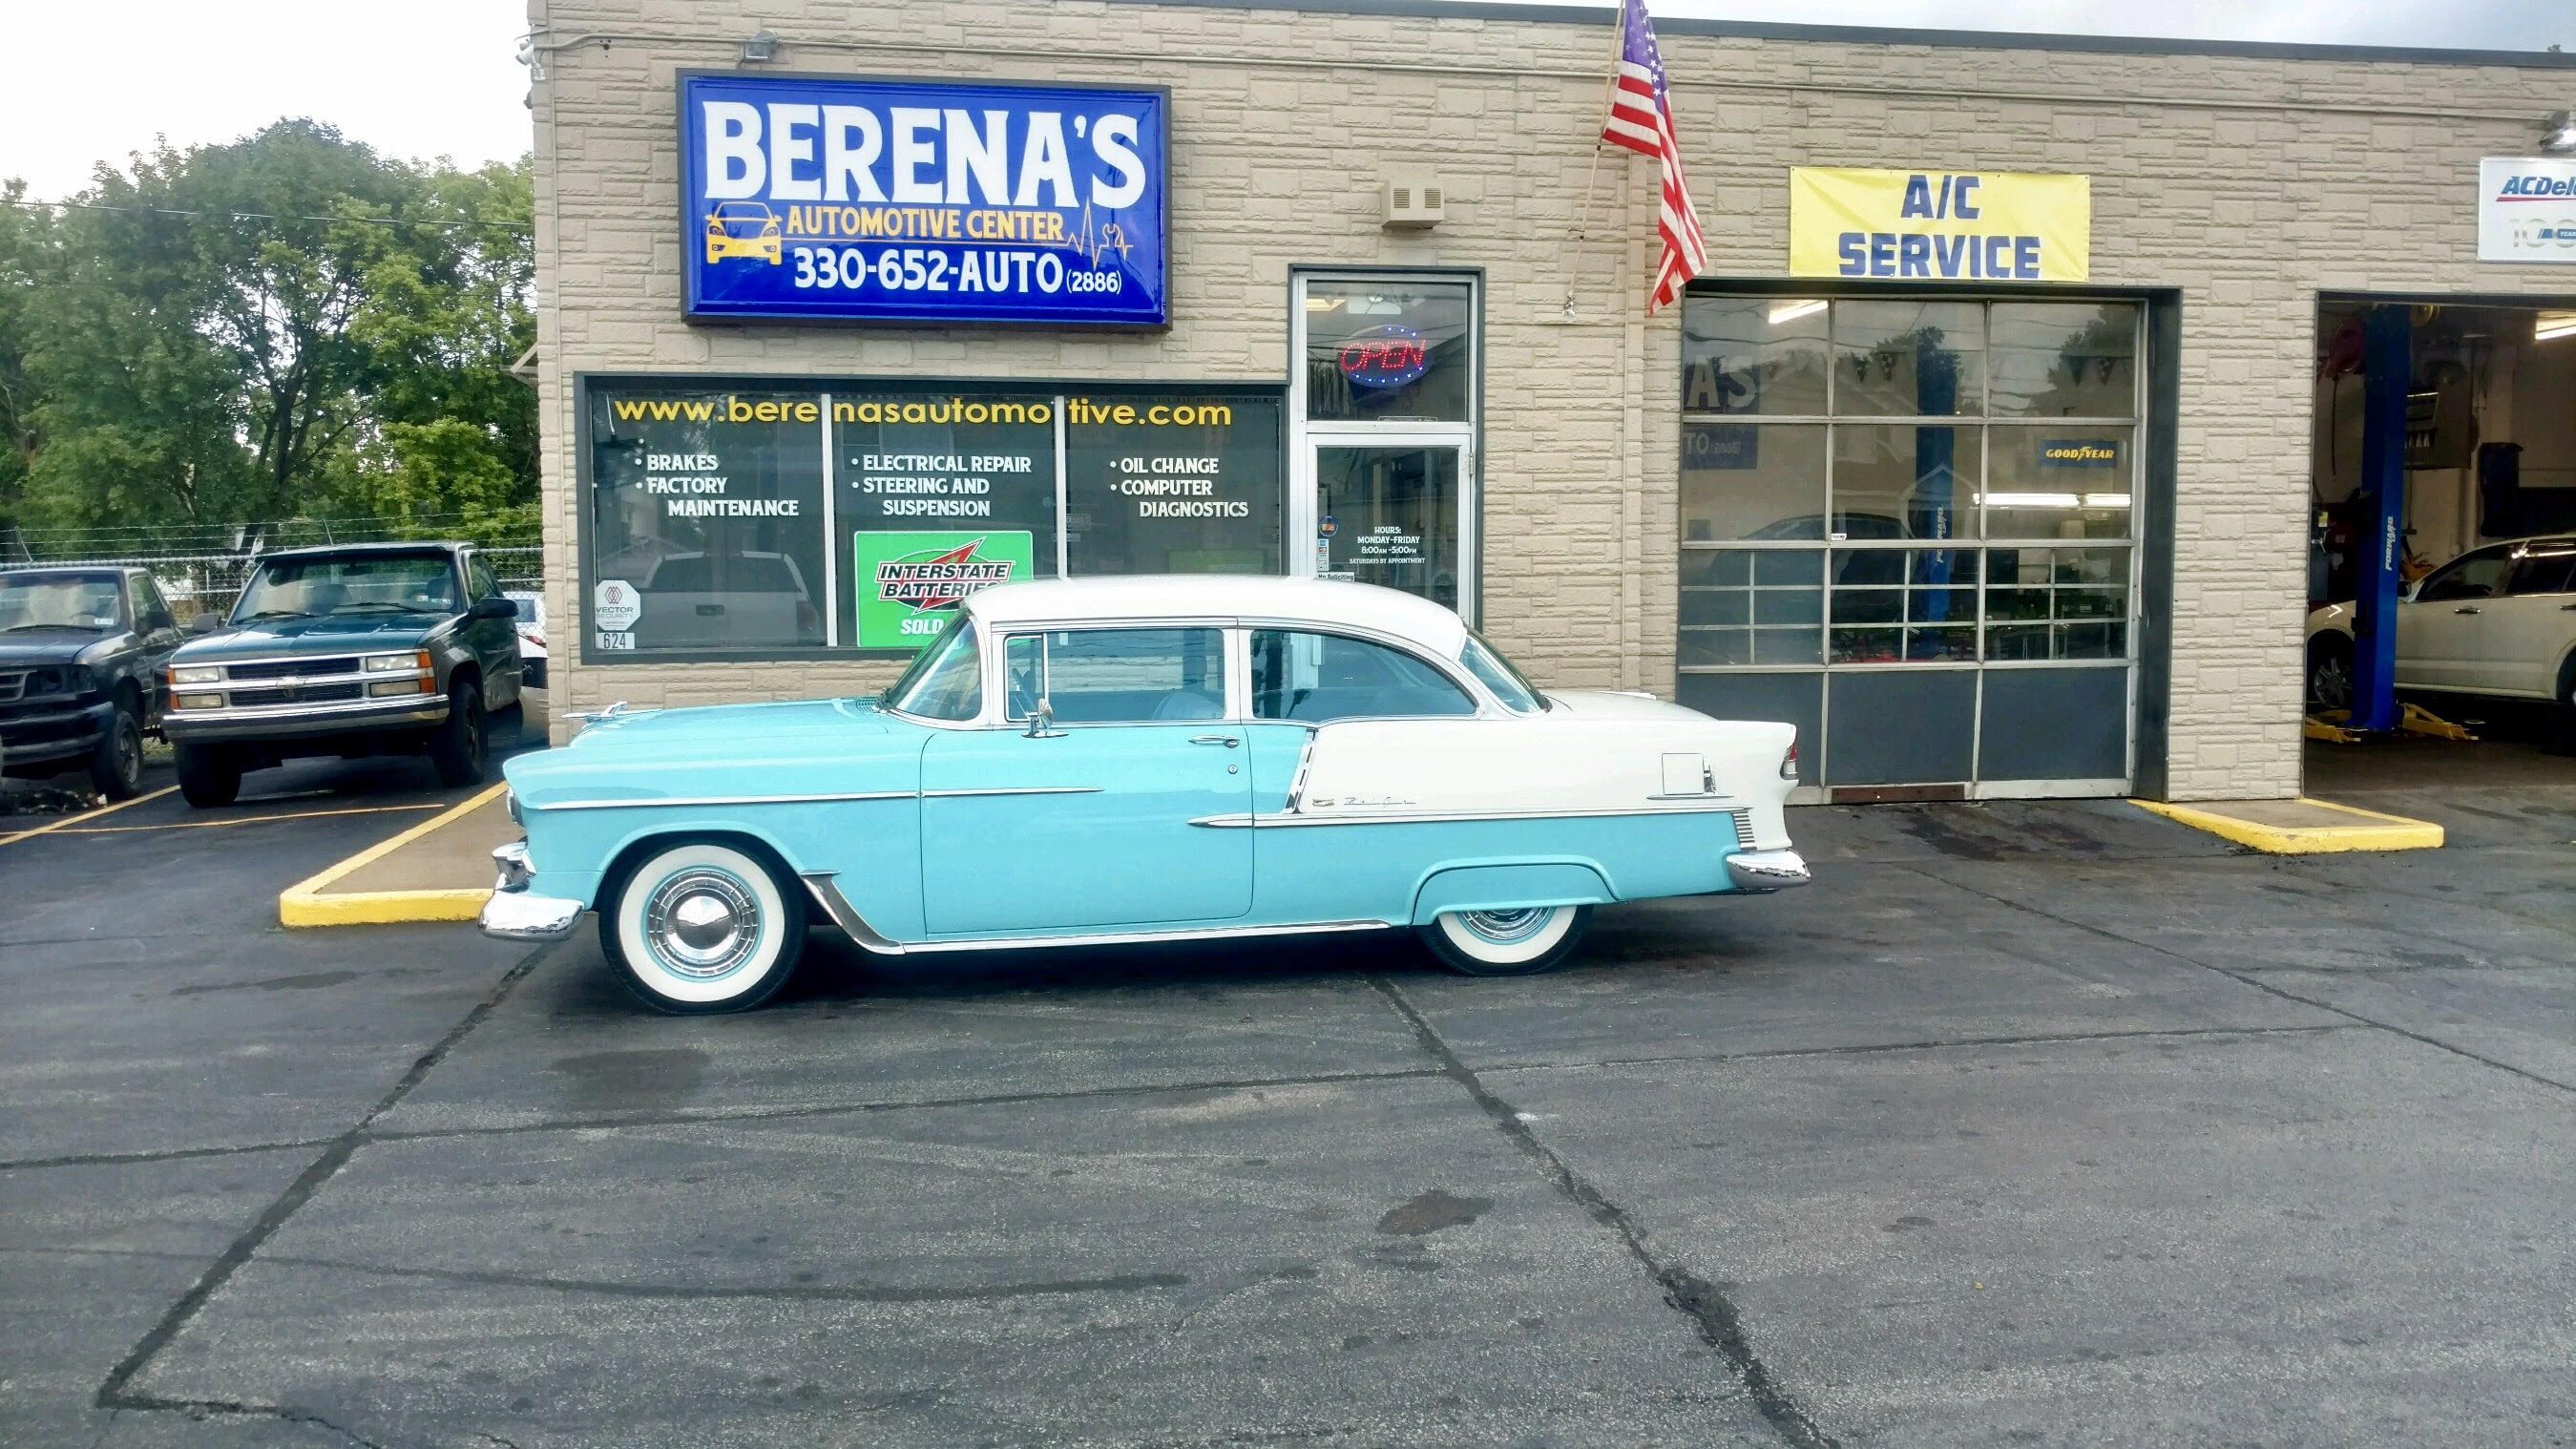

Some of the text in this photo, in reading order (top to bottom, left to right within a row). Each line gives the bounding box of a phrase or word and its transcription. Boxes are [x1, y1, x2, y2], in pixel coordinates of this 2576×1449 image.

[702, 100, 1147, 209] BERENA'S
[2501, 176, 2576, 196] ACDel
[1900, 174, 1981, 220] A/C
[785, 205, 1064, 242] AUTOMOTIVE CENTER
[1838, 232, 2041, 280] SERVICE
[794, 247, 1122, 294] 330-652-AUTO (2886)
[1341, 339, 1427, 372] OPEN
[646, 453, 719, 472] BRAKES
[2045, 447, 2115, 460] GOODYEAR
[863, 453, 1032, 473] ELECTRICAL REPAIR
[1120, 457, 1220, 474] OIL CHANGE
[646, 476, 728, 494] FACTORY
[863, 476, 990, 494] STEERING AND
[1120, 479, 1213, 496] COMPUTER
[667, 499, 800, 517] MAINTENANCE
[883, 499, 991, 517] SUSPENSION
[1139, 501, 1249, 518] DIAGNOSTICS
[1373, 526, 1402, 535] HOURS:
[880, 563, 1008, 579] INTERSTATE
[603, 633, 627, 649] 624
